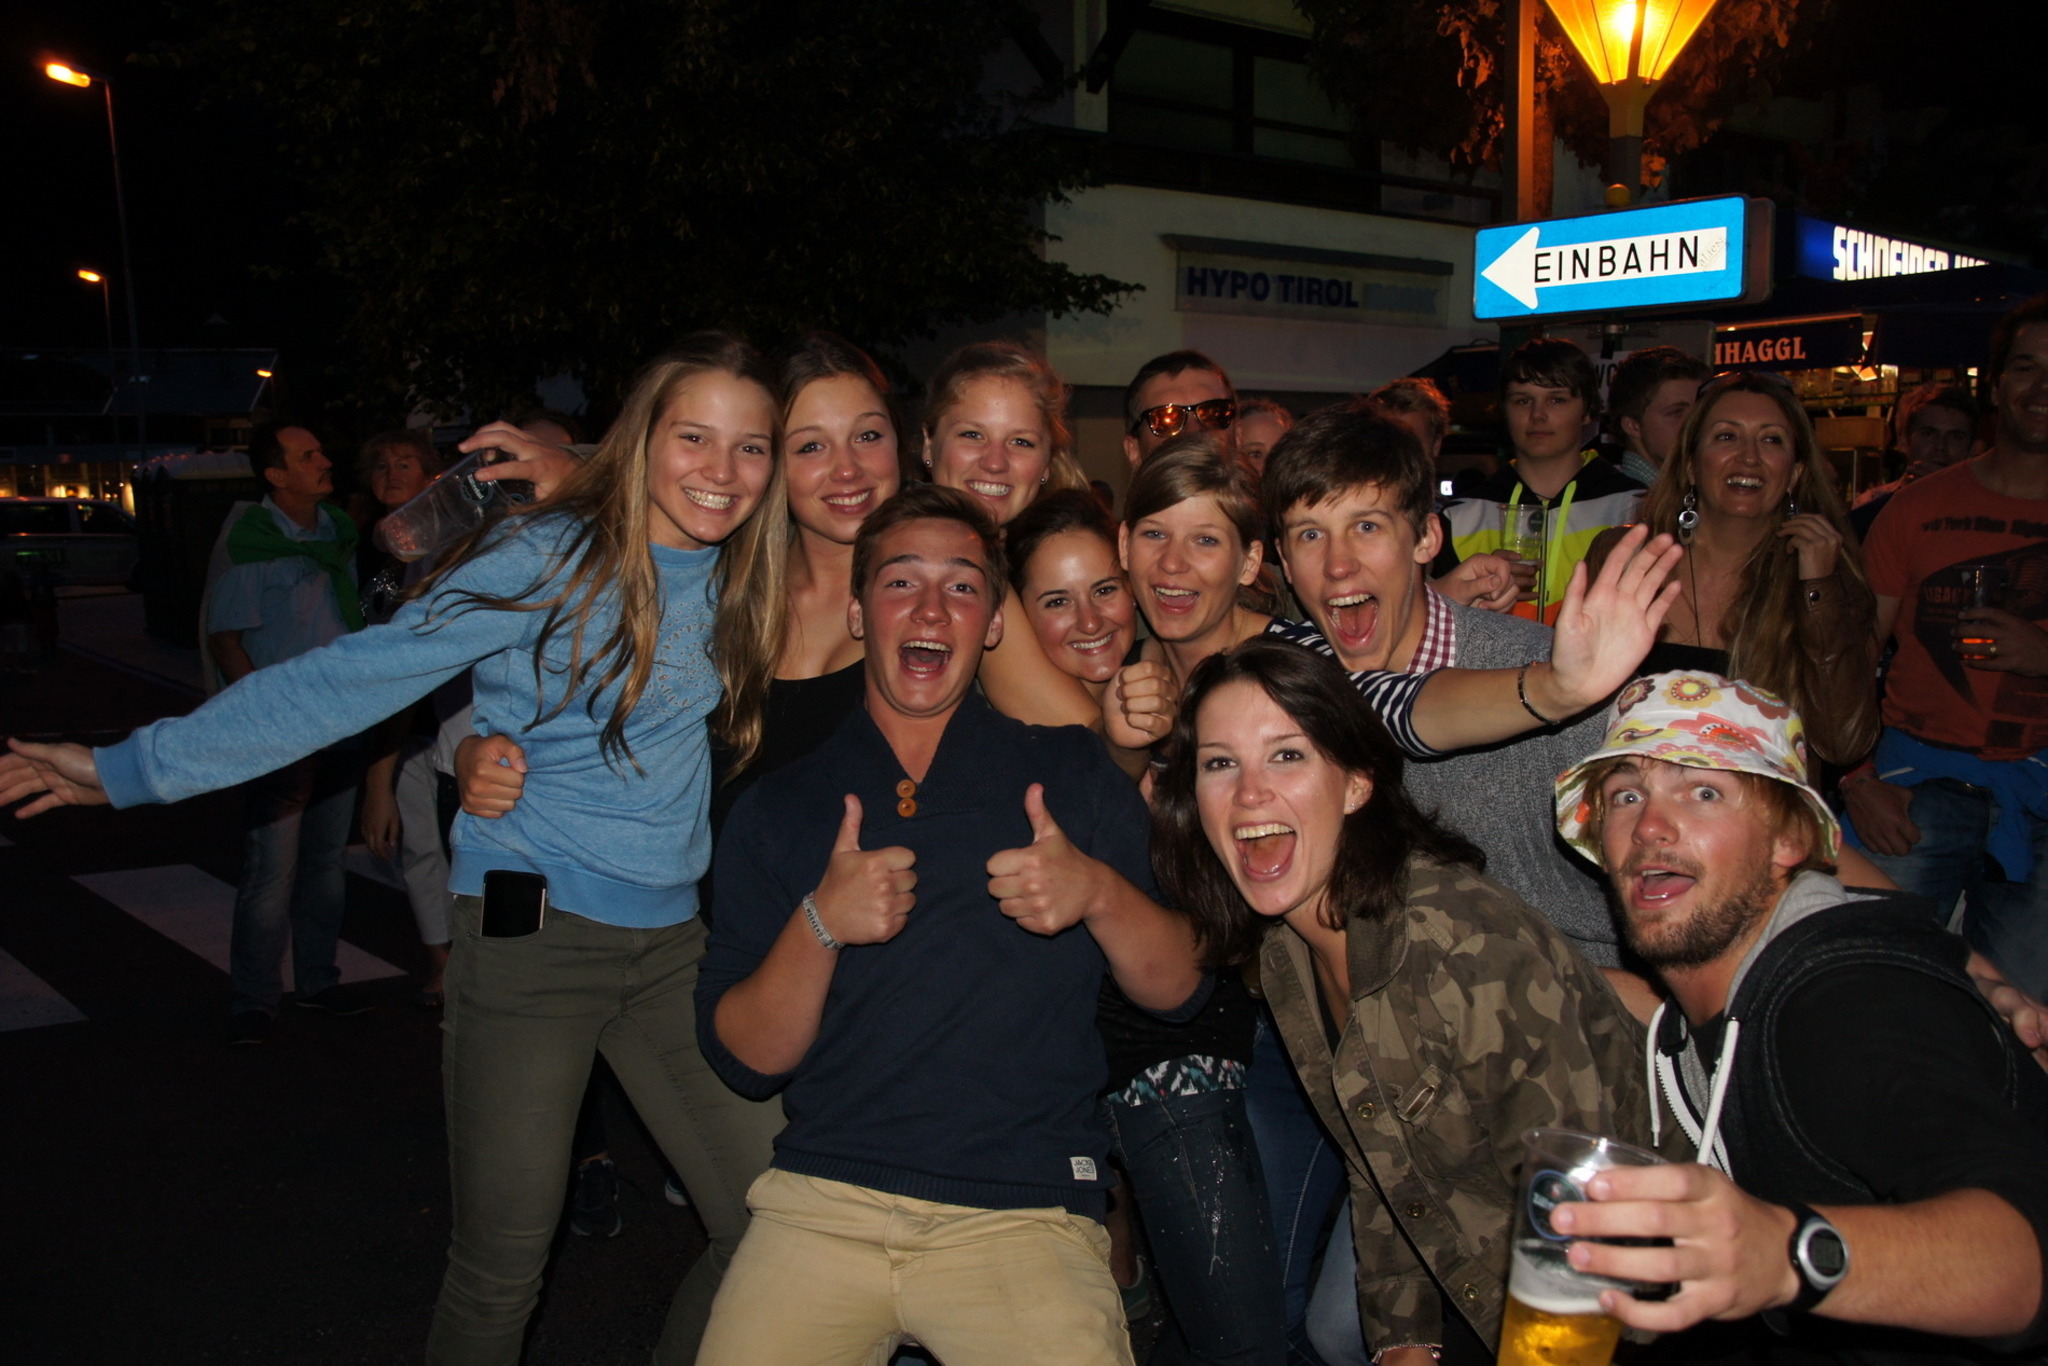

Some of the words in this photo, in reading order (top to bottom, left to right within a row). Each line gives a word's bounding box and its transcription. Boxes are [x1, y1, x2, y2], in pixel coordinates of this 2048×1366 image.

[1534, 235, 1698, 283] EINBAHN
[1187, 265, 1271, 301] HYPO
[1278, 274, 1360, 308] TIROL
